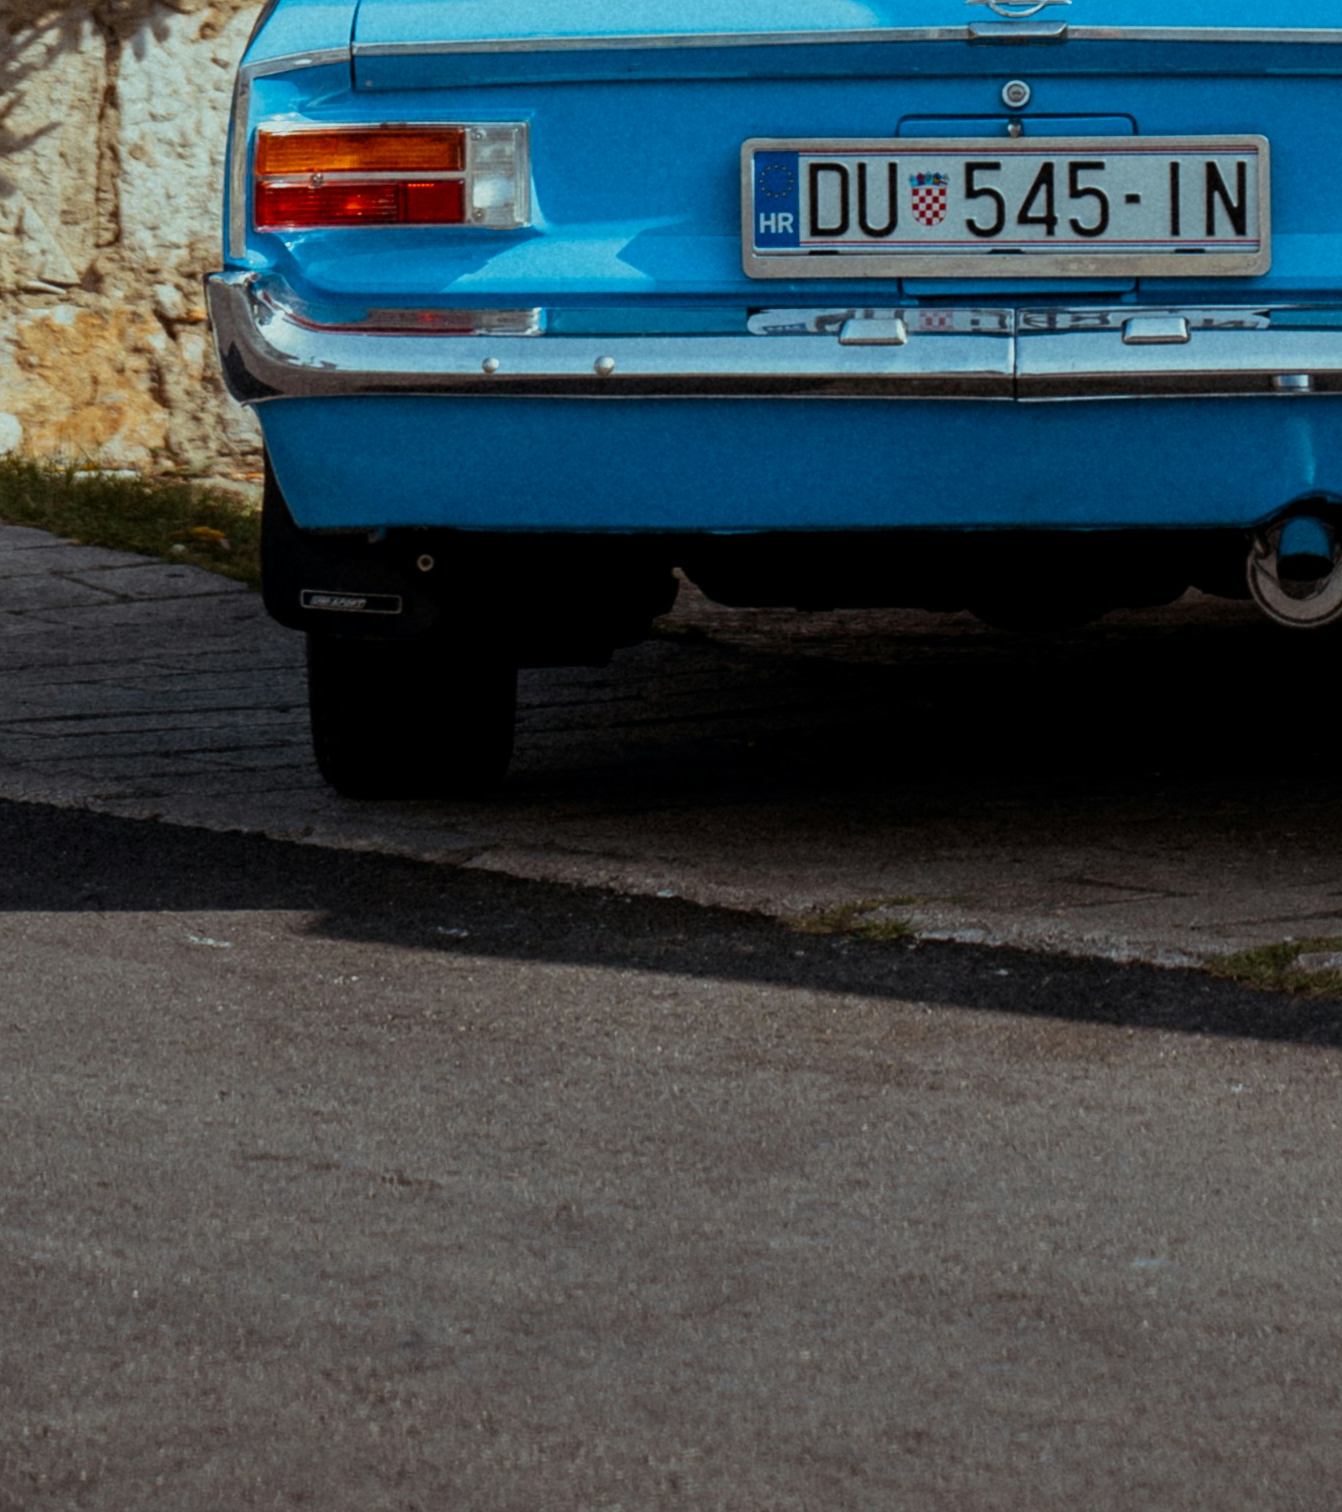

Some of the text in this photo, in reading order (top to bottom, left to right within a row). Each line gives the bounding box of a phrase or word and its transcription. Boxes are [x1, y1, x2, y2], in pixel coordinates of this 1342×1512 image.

[759, 212, 794, 234] HR
[808, 161, 1248, 237] DU 545-IN
